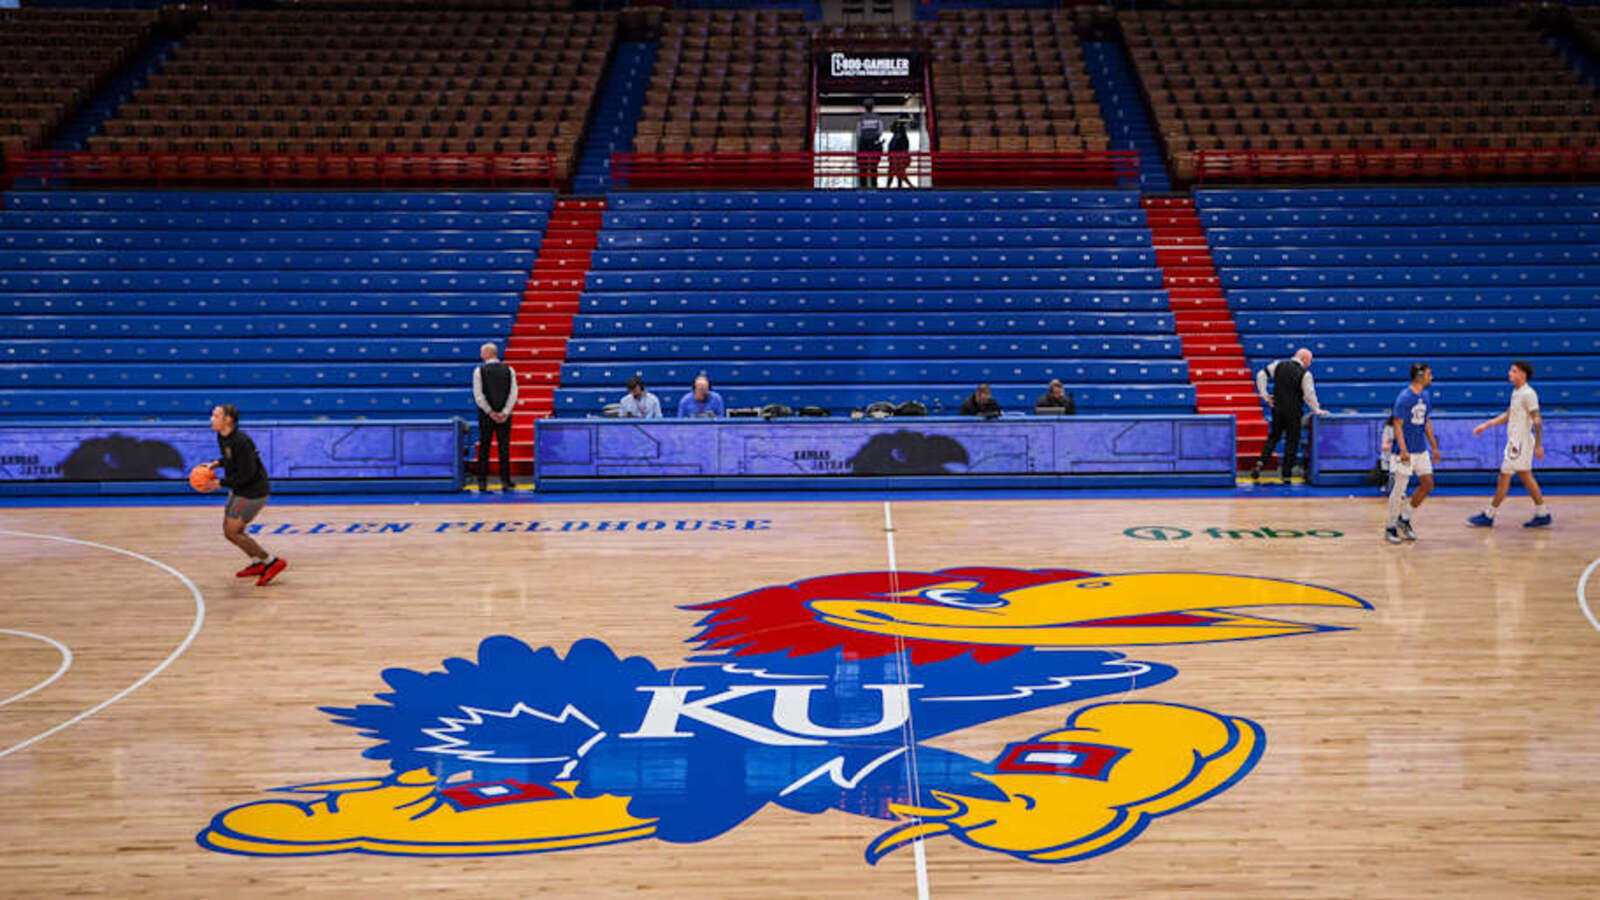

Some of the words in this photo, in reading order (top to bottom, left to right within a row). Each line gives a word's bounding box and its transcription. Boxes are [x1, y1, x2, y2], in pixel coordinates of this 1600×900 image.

[434, 520, 773, 533] FIELDHOUSE
[1203, 526, 1345, 539] fnbo
[619, 683, 925, 746] KU
